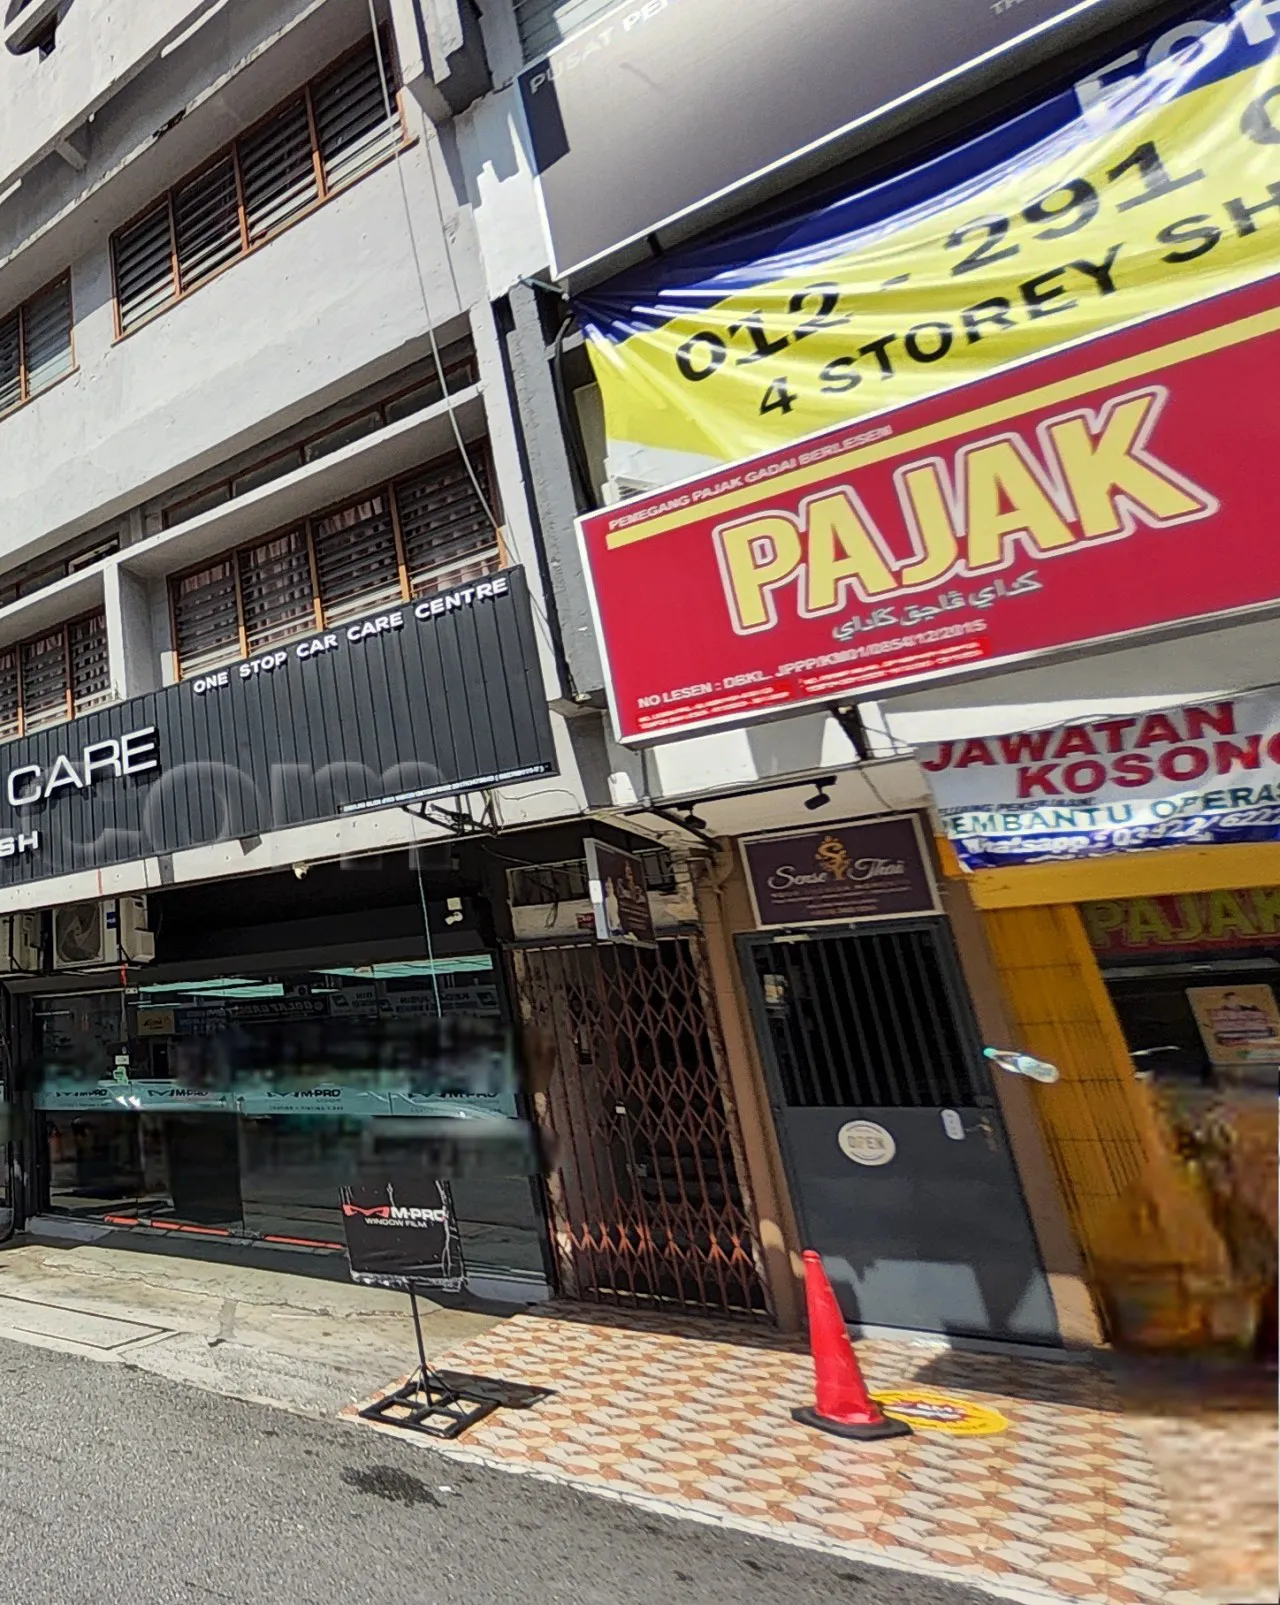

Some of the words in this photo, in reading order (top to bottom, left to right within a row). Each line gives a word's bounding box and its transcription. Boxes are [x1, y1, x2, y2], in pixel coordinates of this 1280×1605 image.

[529, 26, 615, 94] PUSAT
[675, 280, 853, 381] 012
[946, 141, 1204, 276] 291
[759, 377, 798, 416] 4
[821, 246, 1124, 394] STOREY
[609, 495, 691, 530] PEMEGANG
[693, 476, 743, 502] PAJAK
[745, 457, 797, 483] GADAI
[713, 385, 1219, 634] PAJAK
[193, 672, 229, 695] ONE
[238, 652, 287, 680] STOP
[296, 635, 339, 660] CAR
[347, 611, 403, 642] CARE
[415, 577, 510, 621] CENTRE
[638, 695, 661, 709] NO
[663, 681, 713, 704] LESEN
[7, 726, 157, 807] CARE
[922, 701, 1237, 772] JAWATAN
[1151, 783, 1280, 819] OPERA
[365, 1217, 403, 1228] WINDOW
[405, 1219, 428, 1229] FILM
[391, 1206, 445, 1222] M-PRO
